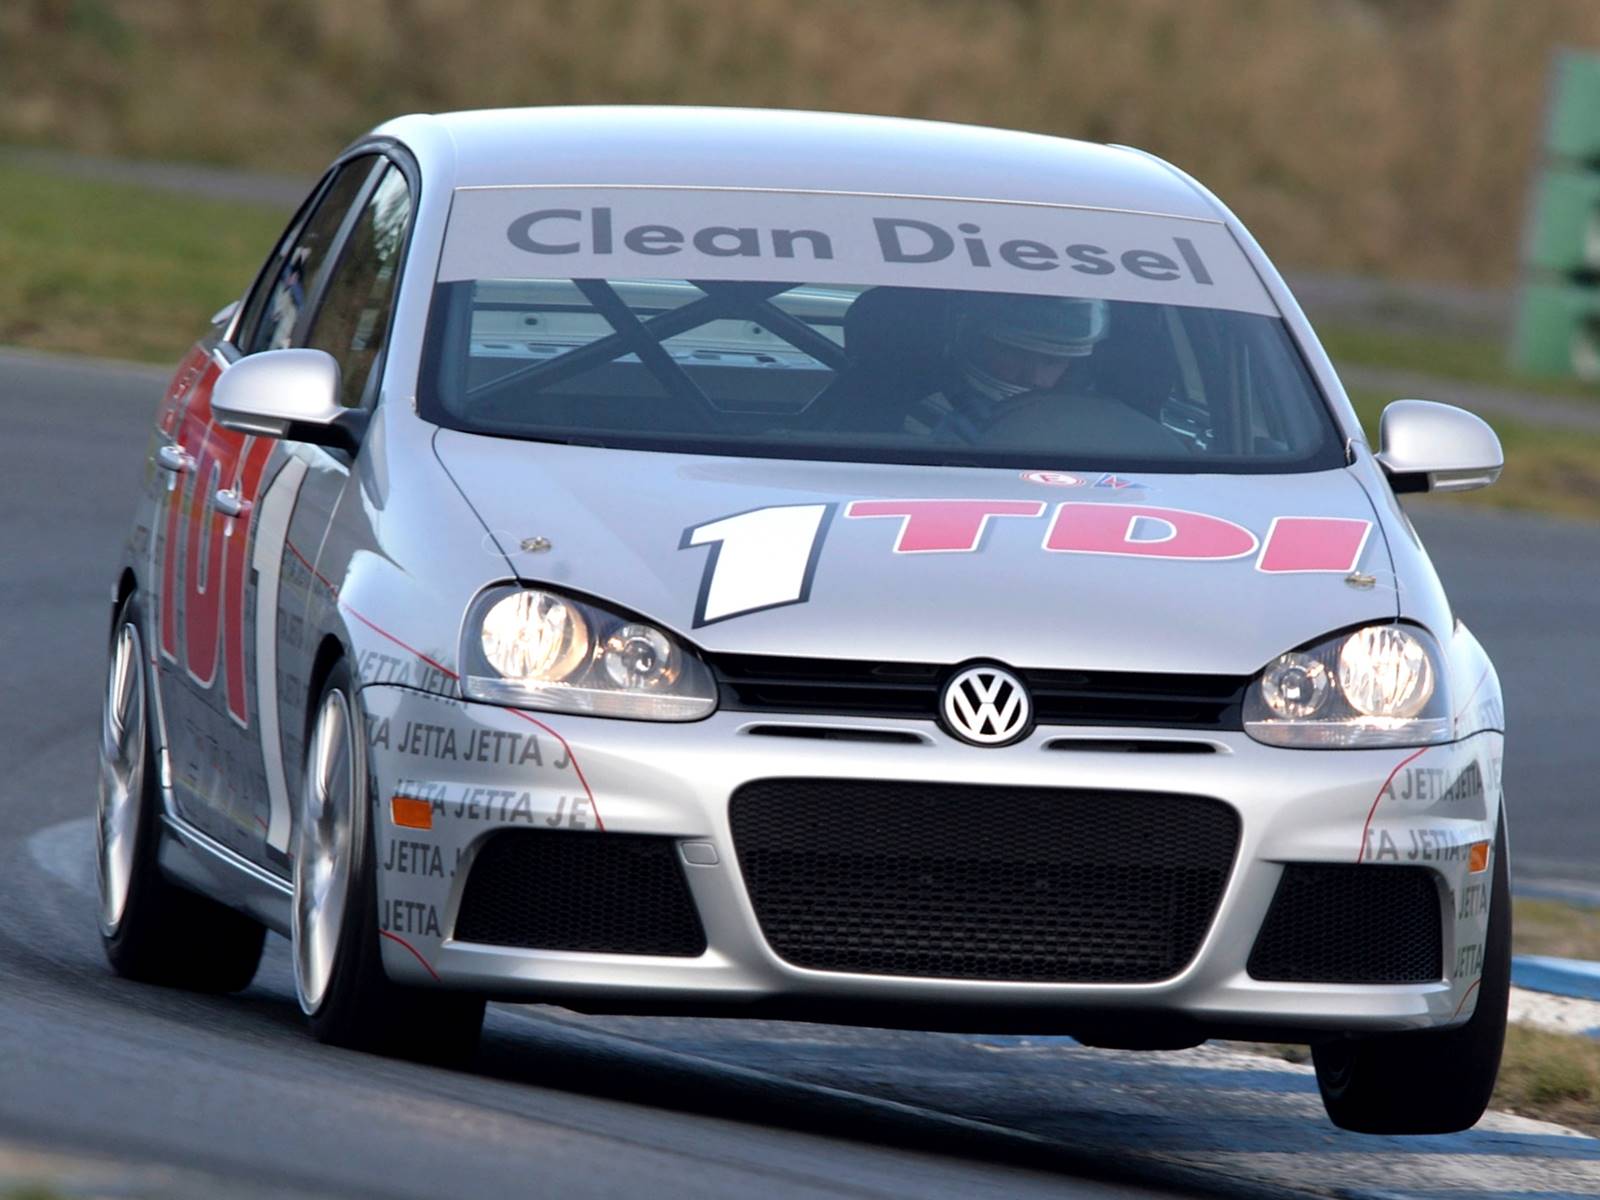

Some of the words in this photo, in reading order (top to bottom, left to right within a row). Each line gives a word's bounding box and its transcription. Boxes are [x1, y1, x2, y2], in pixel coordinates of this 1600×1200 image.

[507, 208, 833, 260] Clean
[873, 216, 1215, 286] Diesel
[679, 502, 838, 629] 1
[844, 498, 1373, 573] TDI
[398, 721, 457, 761] JETTA
[463, 728, 543, 767] JETTA
[454, 789, 534, 824] JETTA
[384, 840, 445, 878] JETTA
[1407, 829, 1461, 861] JETTA
[382, 900, 442, 938] JETTA
